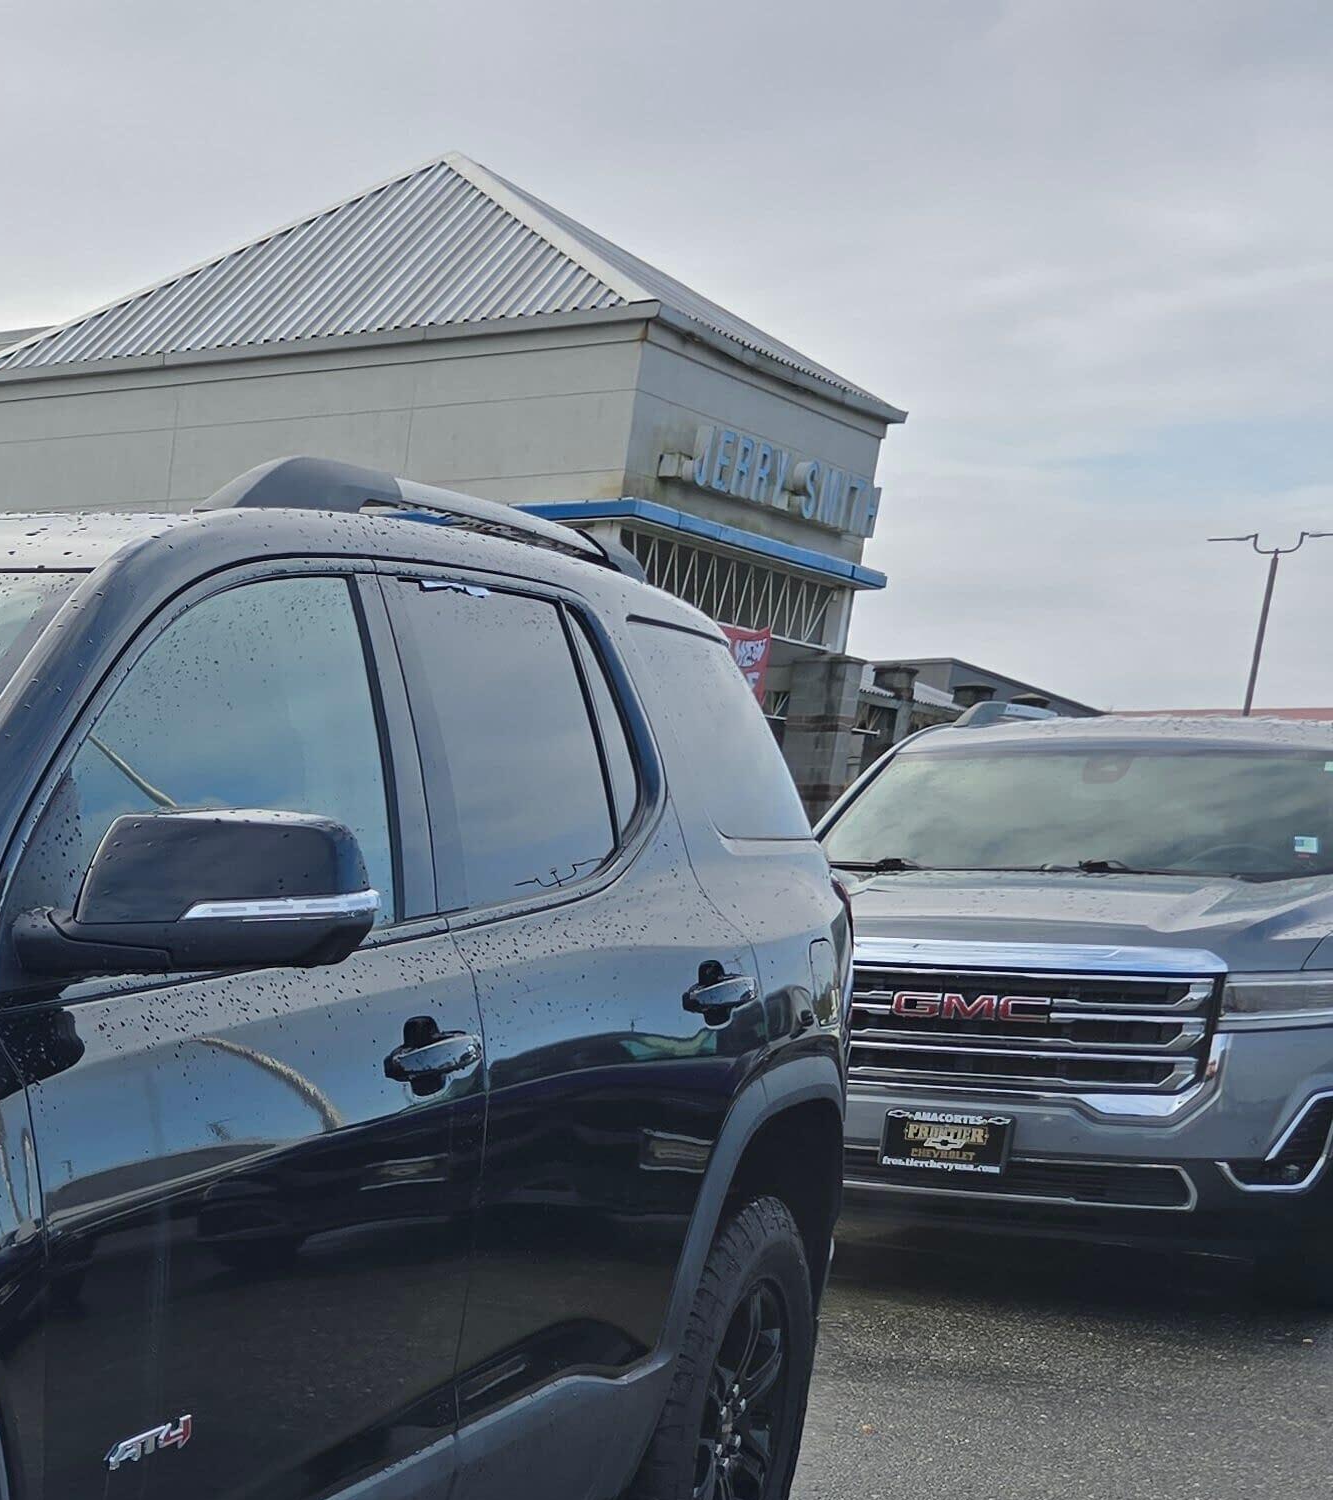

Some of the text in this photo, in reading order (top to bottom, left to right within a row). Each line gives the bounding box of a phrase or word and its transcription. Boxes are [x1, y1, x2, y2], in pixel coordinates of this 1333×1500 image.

[687, 425, 791, 510] JERRY
[892, 991, 1051, 1023] GMC
[913, 1111, 983, 1125] ANACORTES
[910, 1148, 976, 1160] CHEVROLET
[106, 1414, 192, 1471] AT4
